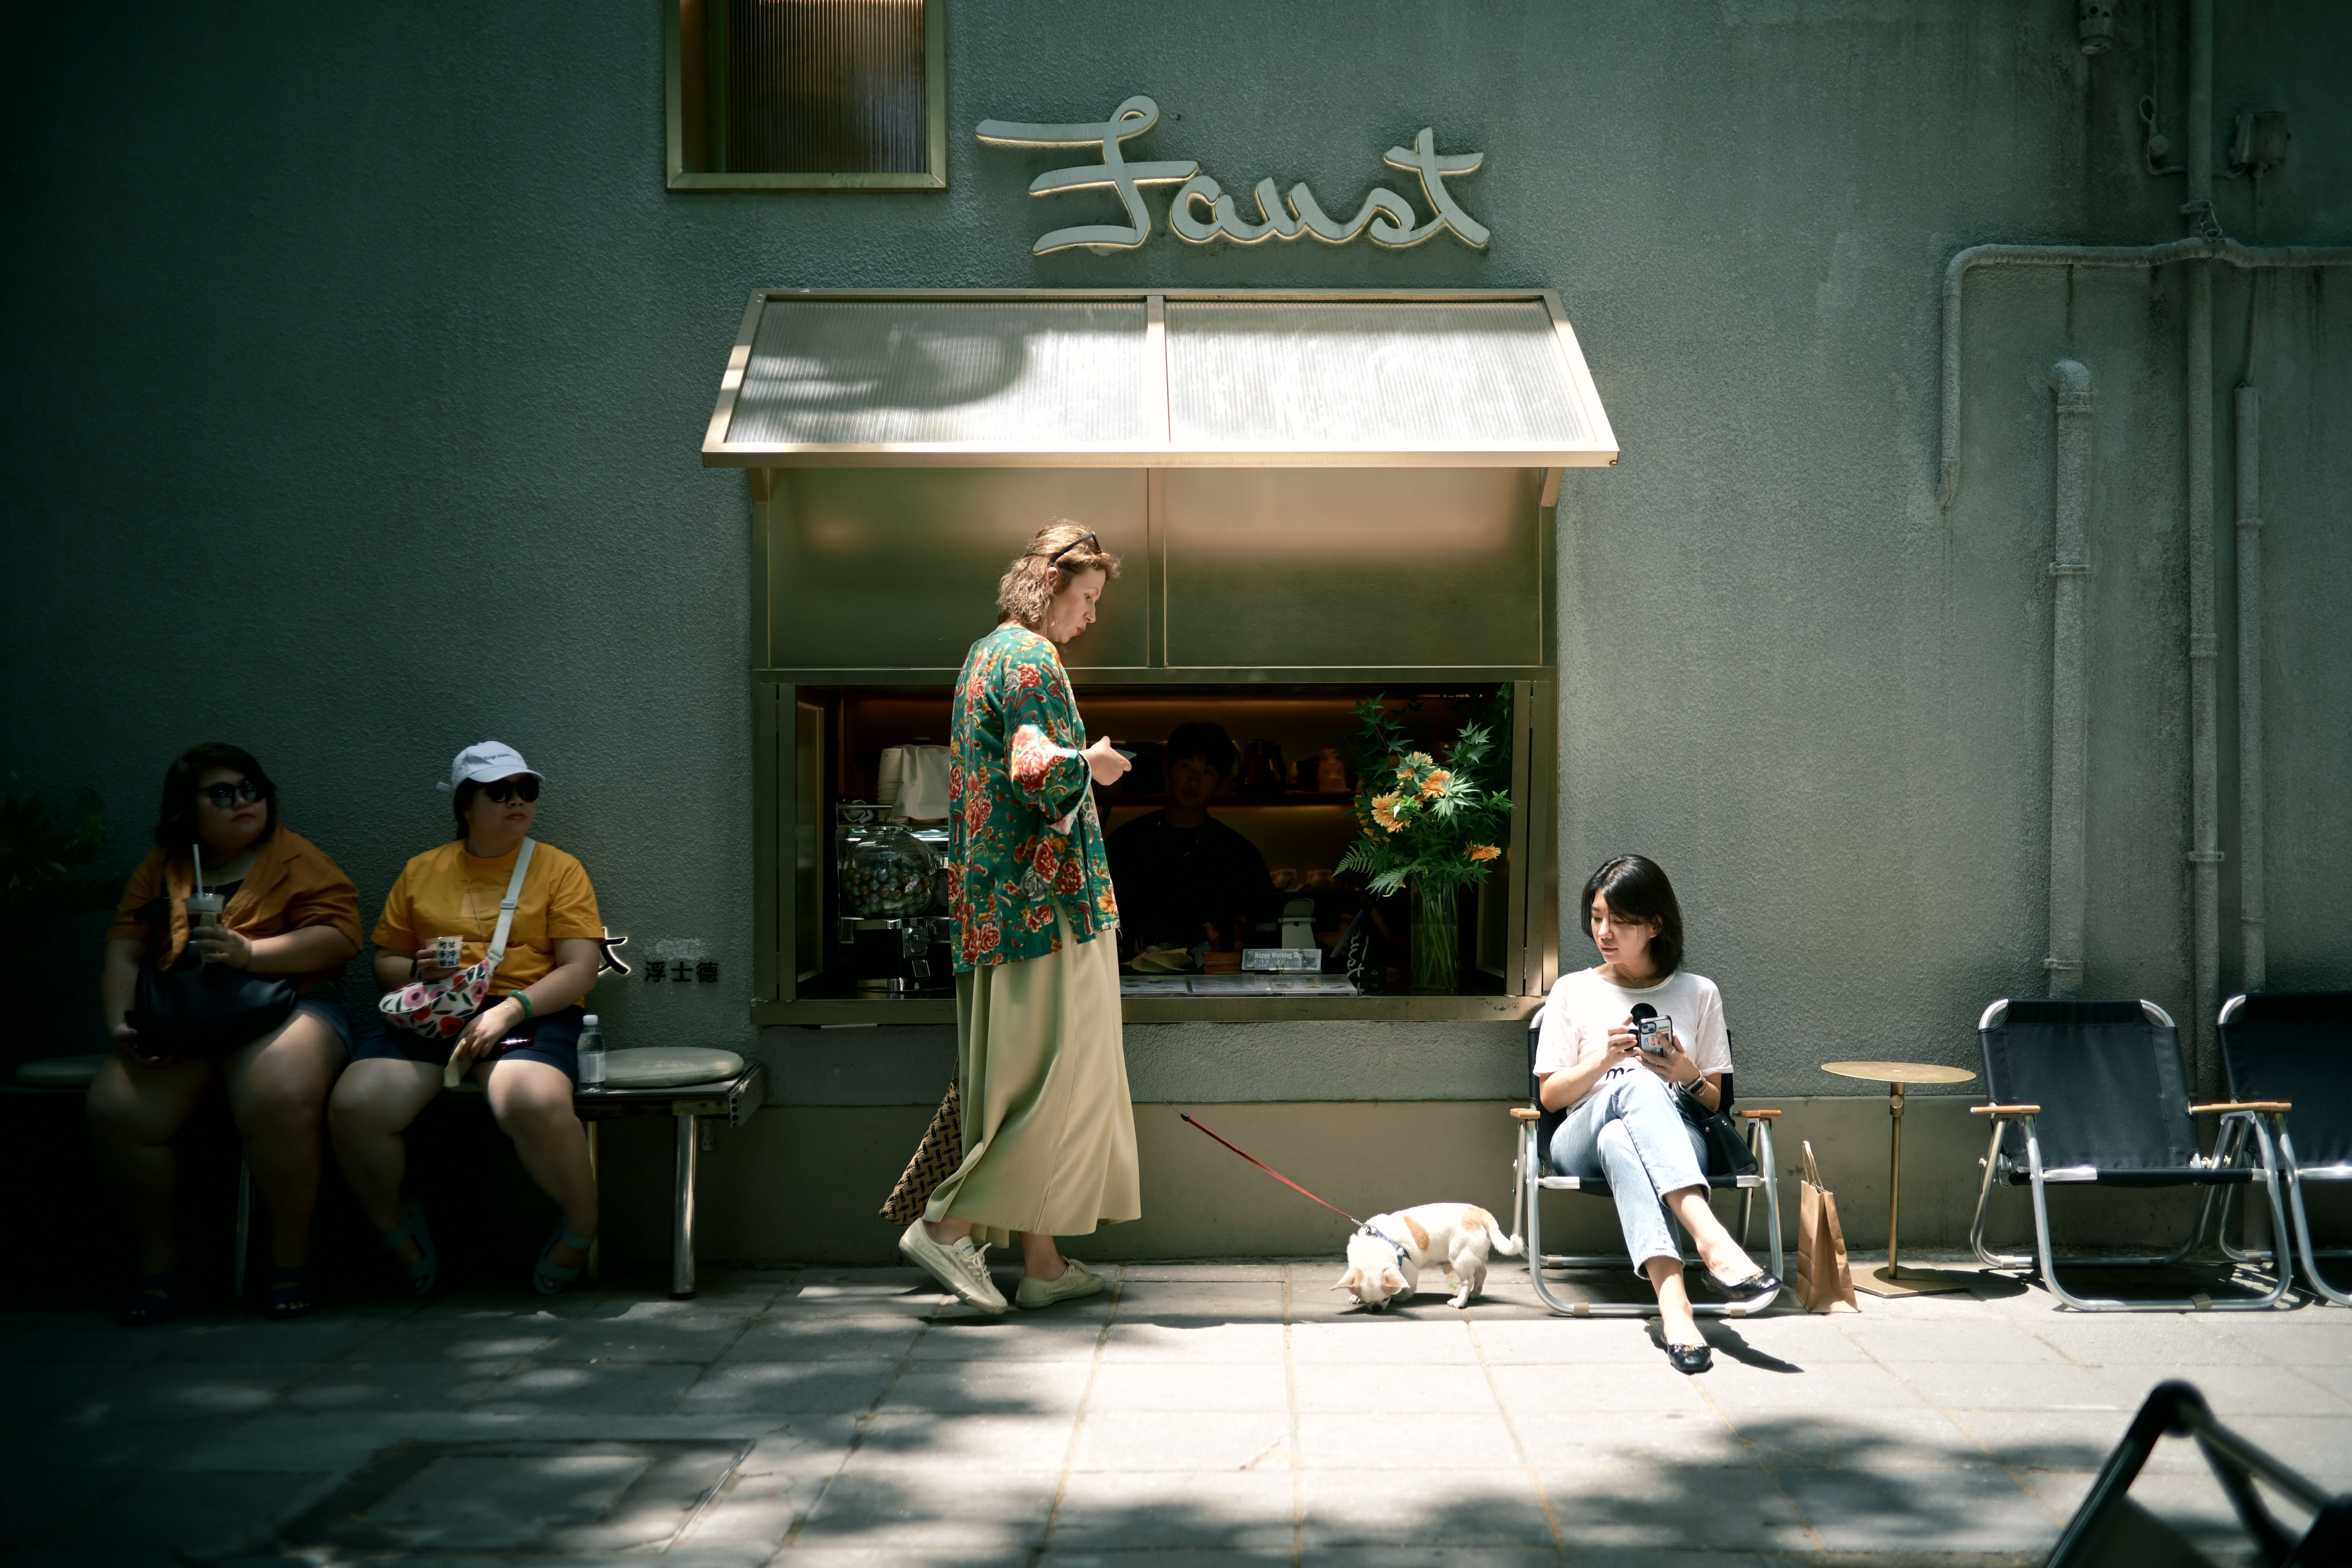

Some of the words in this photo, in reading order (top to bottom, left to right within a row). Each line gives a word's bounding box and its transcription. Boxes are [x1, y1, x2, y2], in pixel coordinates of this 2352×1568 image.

[975, 96, 1490, 255] Faust
[644, 961, 718, 983] 浮士德
